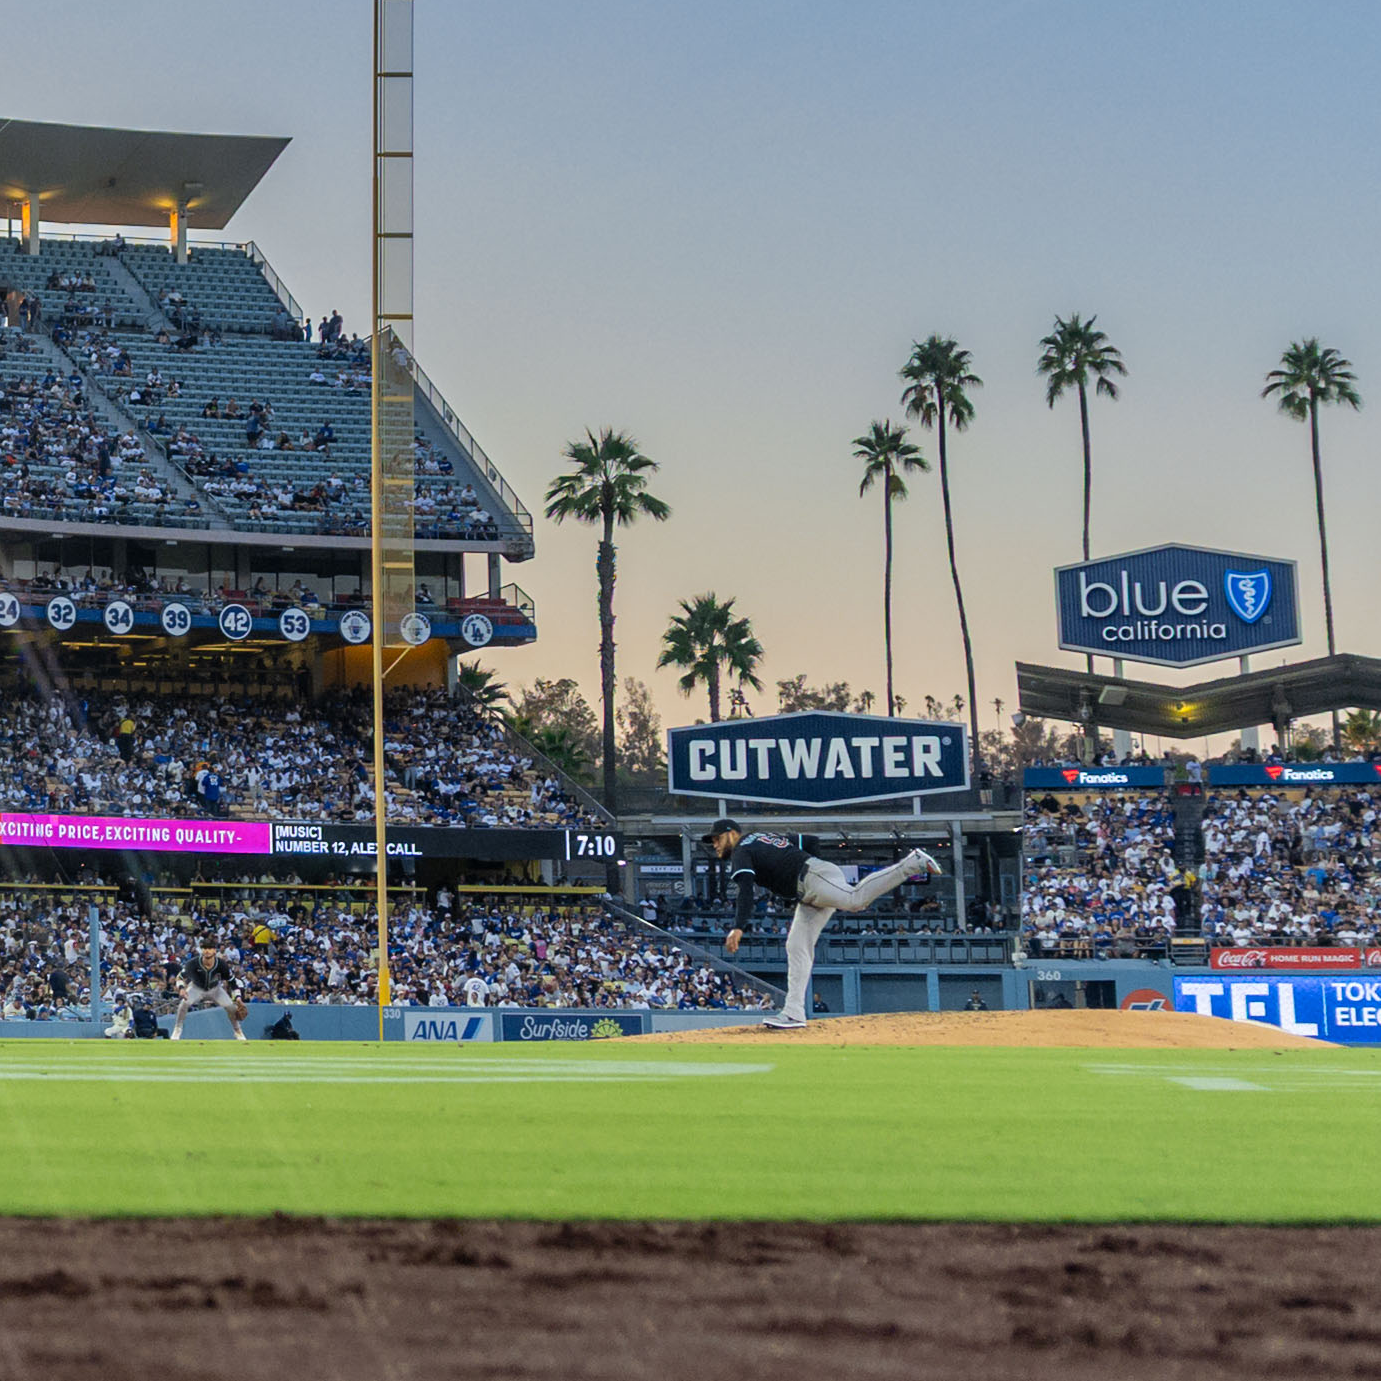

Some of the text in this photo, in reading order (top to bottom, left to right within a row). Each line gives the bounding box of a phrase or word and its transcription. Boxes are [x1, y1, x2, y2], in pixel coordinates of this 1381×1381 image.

[1079, 570, 1209, 618] blue
[50, 603, 73, 623] 32
[108, 608, 131, 628] 34
[165, 610, 188, 629] 39
[223, 612, 248, 632] 42
[284, 615, 308, 635] 53
[1102, 620, 1227, 642] california
[689, 735, 944, 781] CUTWATER
[1079, 771, 1128, 784] Fanatics
[1283, 768, 1334, 781] Fanatics
[274, 824, 322, 842] [MUSIC]
[275, 841, 378, 856] NUMBER 12, ALE
[576, 834, 616, 858] 7:10
[1270, 954, 1355, 963] HOME RUN MAGIC
[1037, 970, 1062, 981] 360
[383, 1008, 401, 1020] 330
[1335, 1007, 1381, 1027] ELE
[412, 1020, 458, 1040] ANA
[520, 1016, 589, 1041] Surfside
